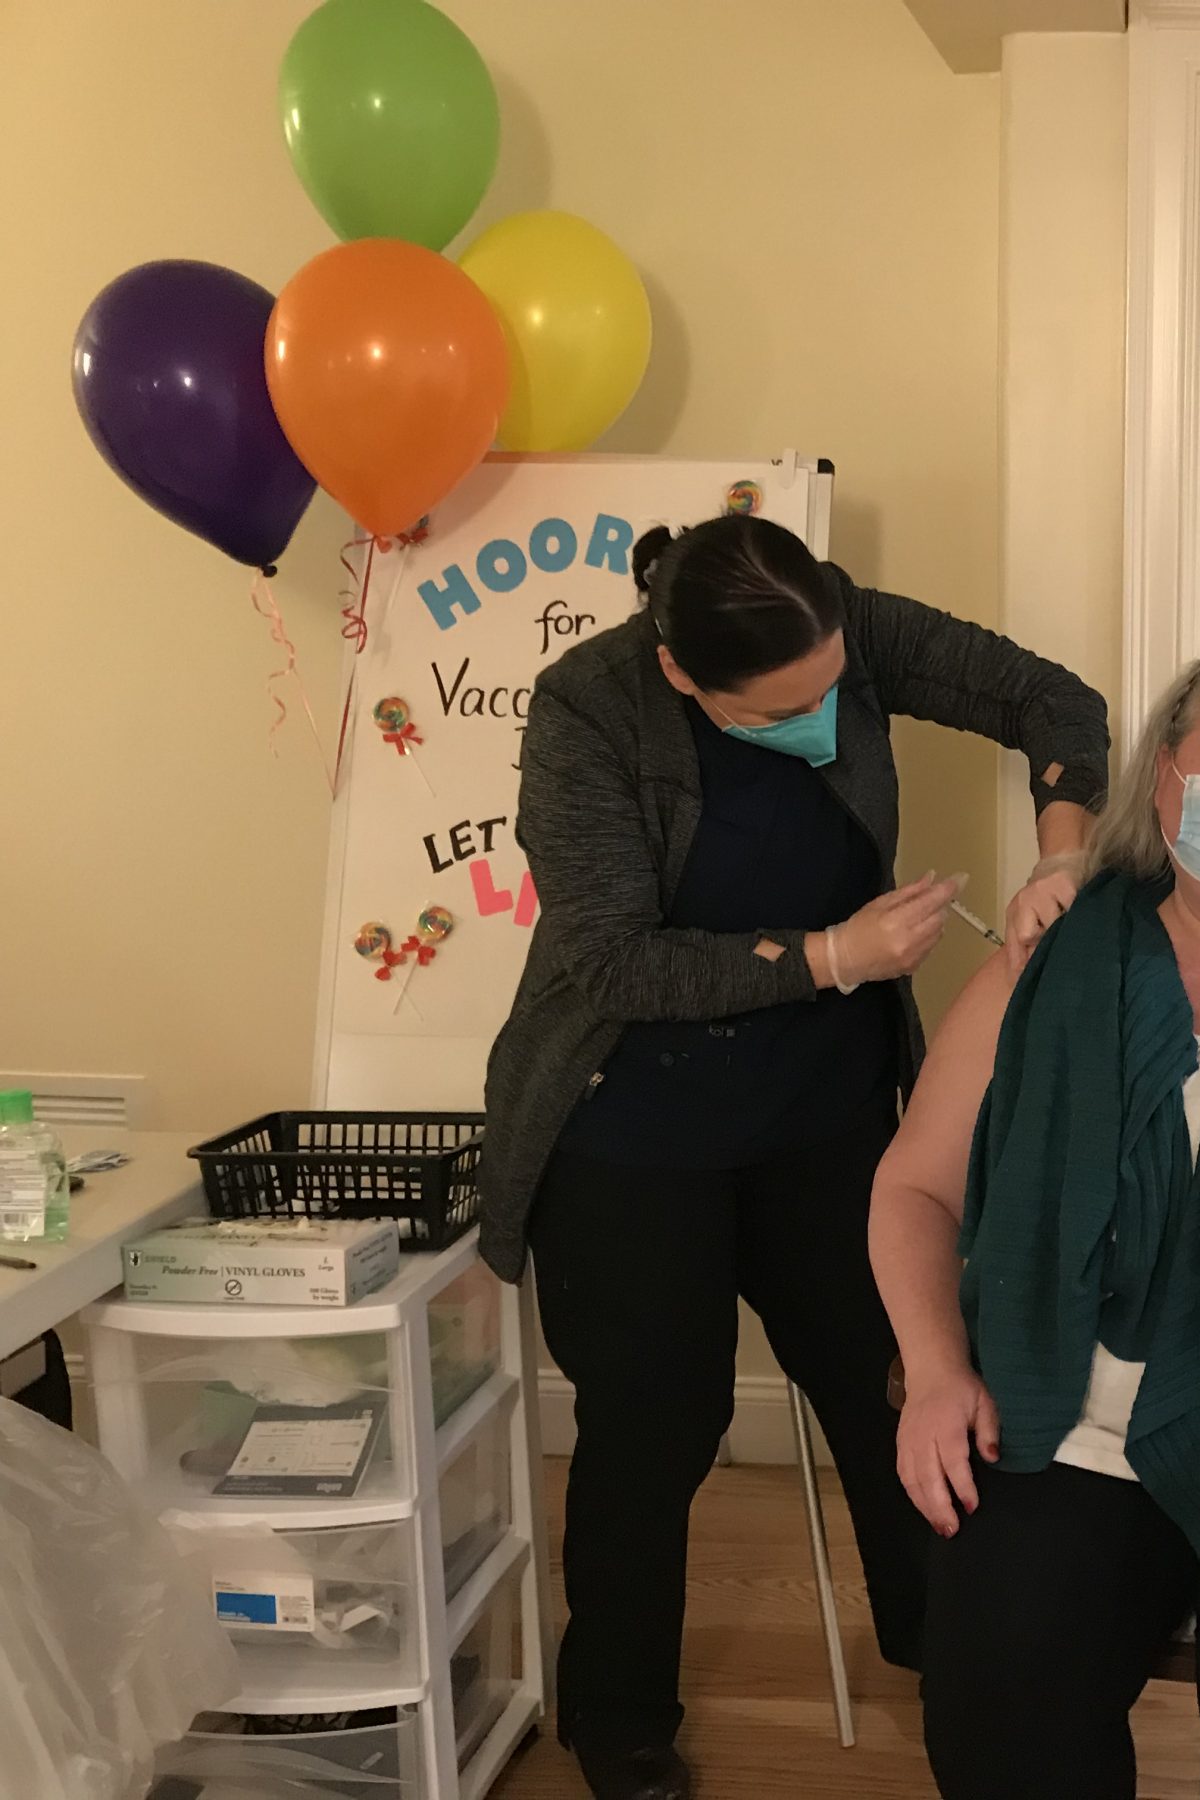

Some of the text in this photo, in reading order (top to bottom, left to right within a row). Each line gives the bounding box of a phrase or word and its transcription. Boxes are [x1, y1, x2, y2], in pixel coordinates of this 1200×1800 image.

[417, 513, 634, 631] HOOR
[535, 600, 596, 655] for
[431, 657, 531, 718] Vacc
[162, 1265, 306, 1278] Powder Free VINYL GLOVES
